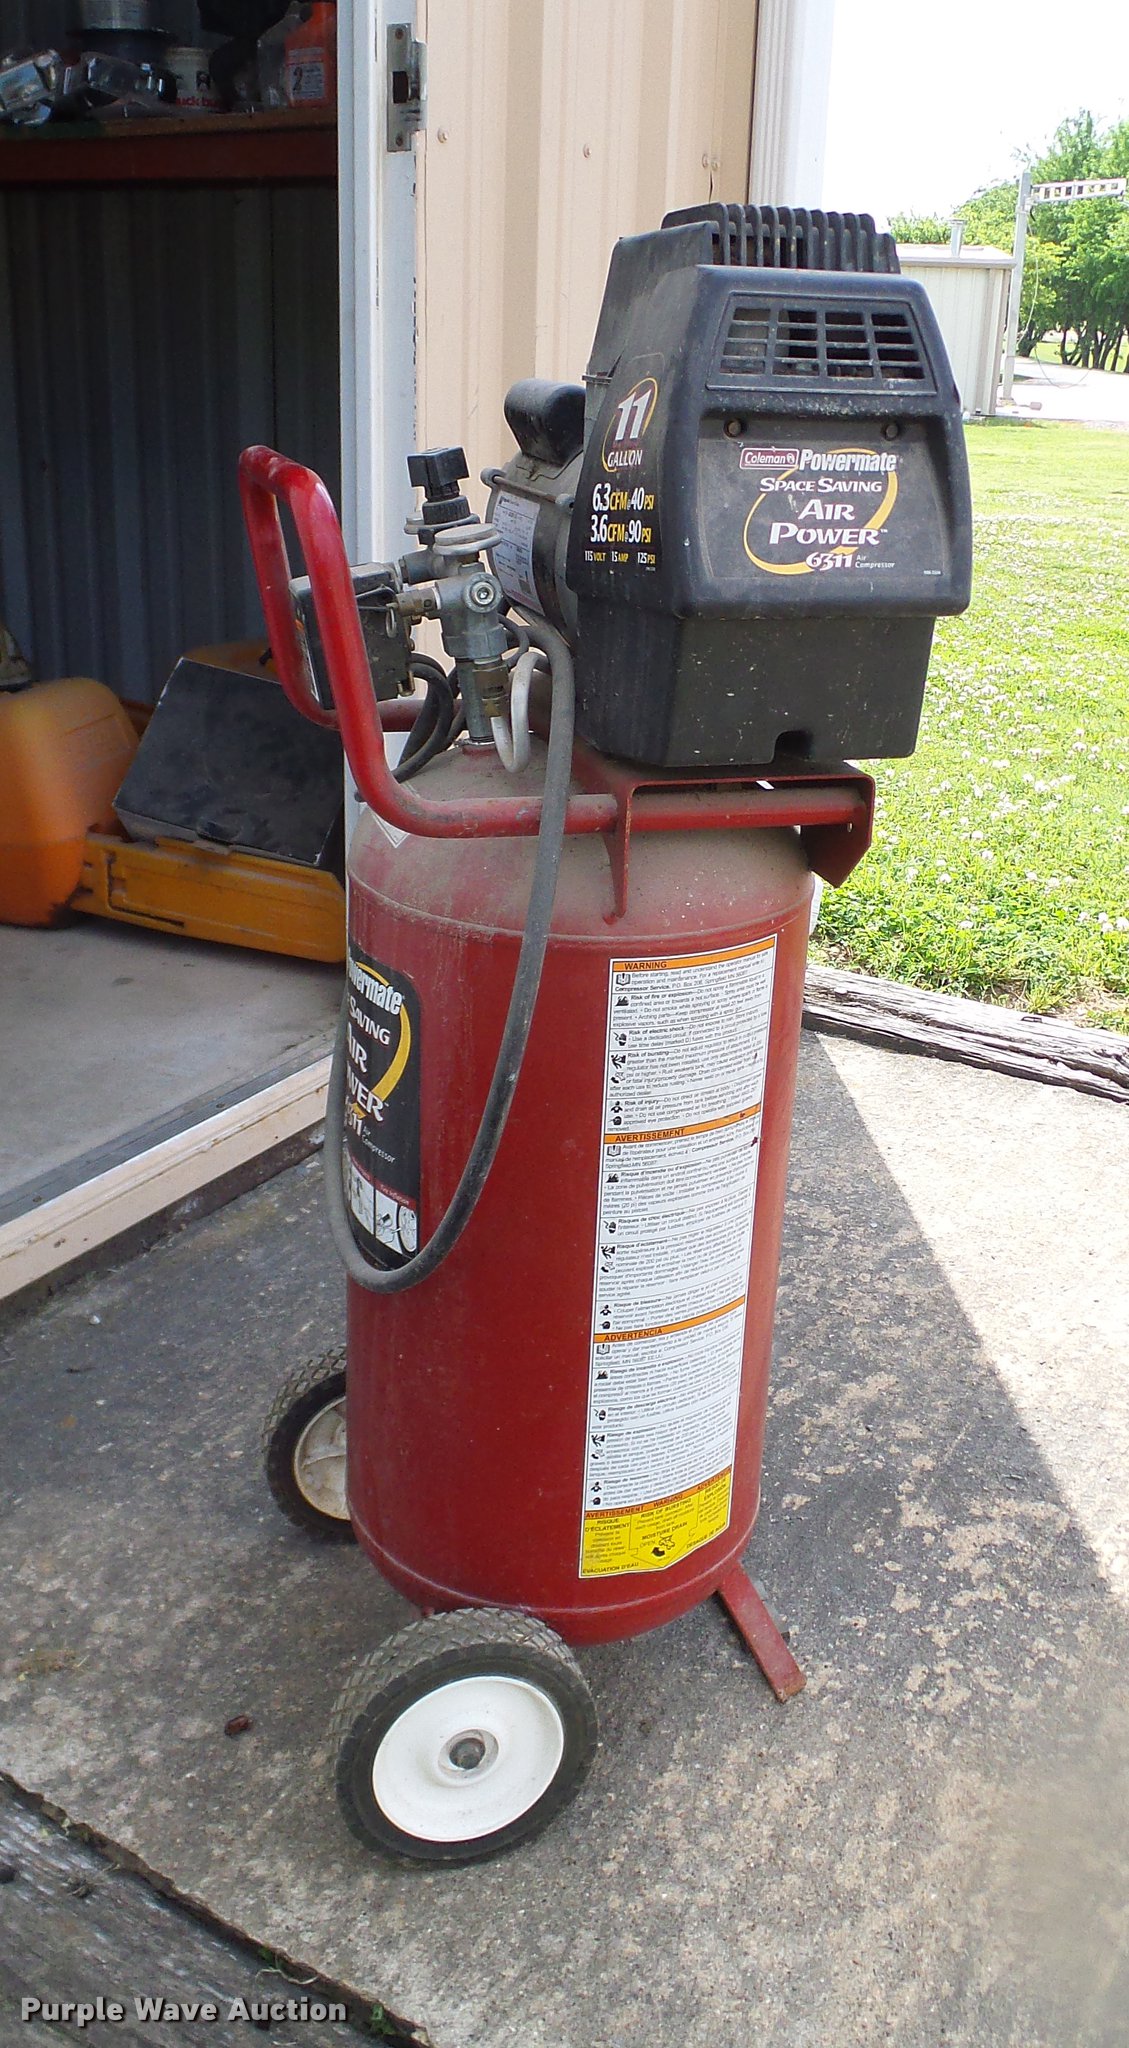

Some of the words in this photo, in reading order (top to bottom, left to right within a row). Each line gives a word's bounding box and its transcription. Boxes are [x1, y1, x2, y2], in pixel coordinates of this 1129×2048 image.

[614, 389, 652, 441] 11
[607, 450, 642, 468] GALLON
[744, 452, 786, 465] Coleman
[798, 448, 897, 472] Powermate
[760, 477, 816, 492] SPACE
[818, 478, 883, 493] SAVING
[798, 498, 856, 521] AIR
[805, 551, 852, 571] 6311
[855, 561, 896, 569] Compressor
[856, 554, 866, 562] Air
[624, 961, 667, 970] WARNING
[615, 1129, 684, 1142] AVERTISSEMENT
[604, 1328, 663, 1342] ADVERTENCIA
[586, 1506, 644, 1518] AVERTISSEMENT
